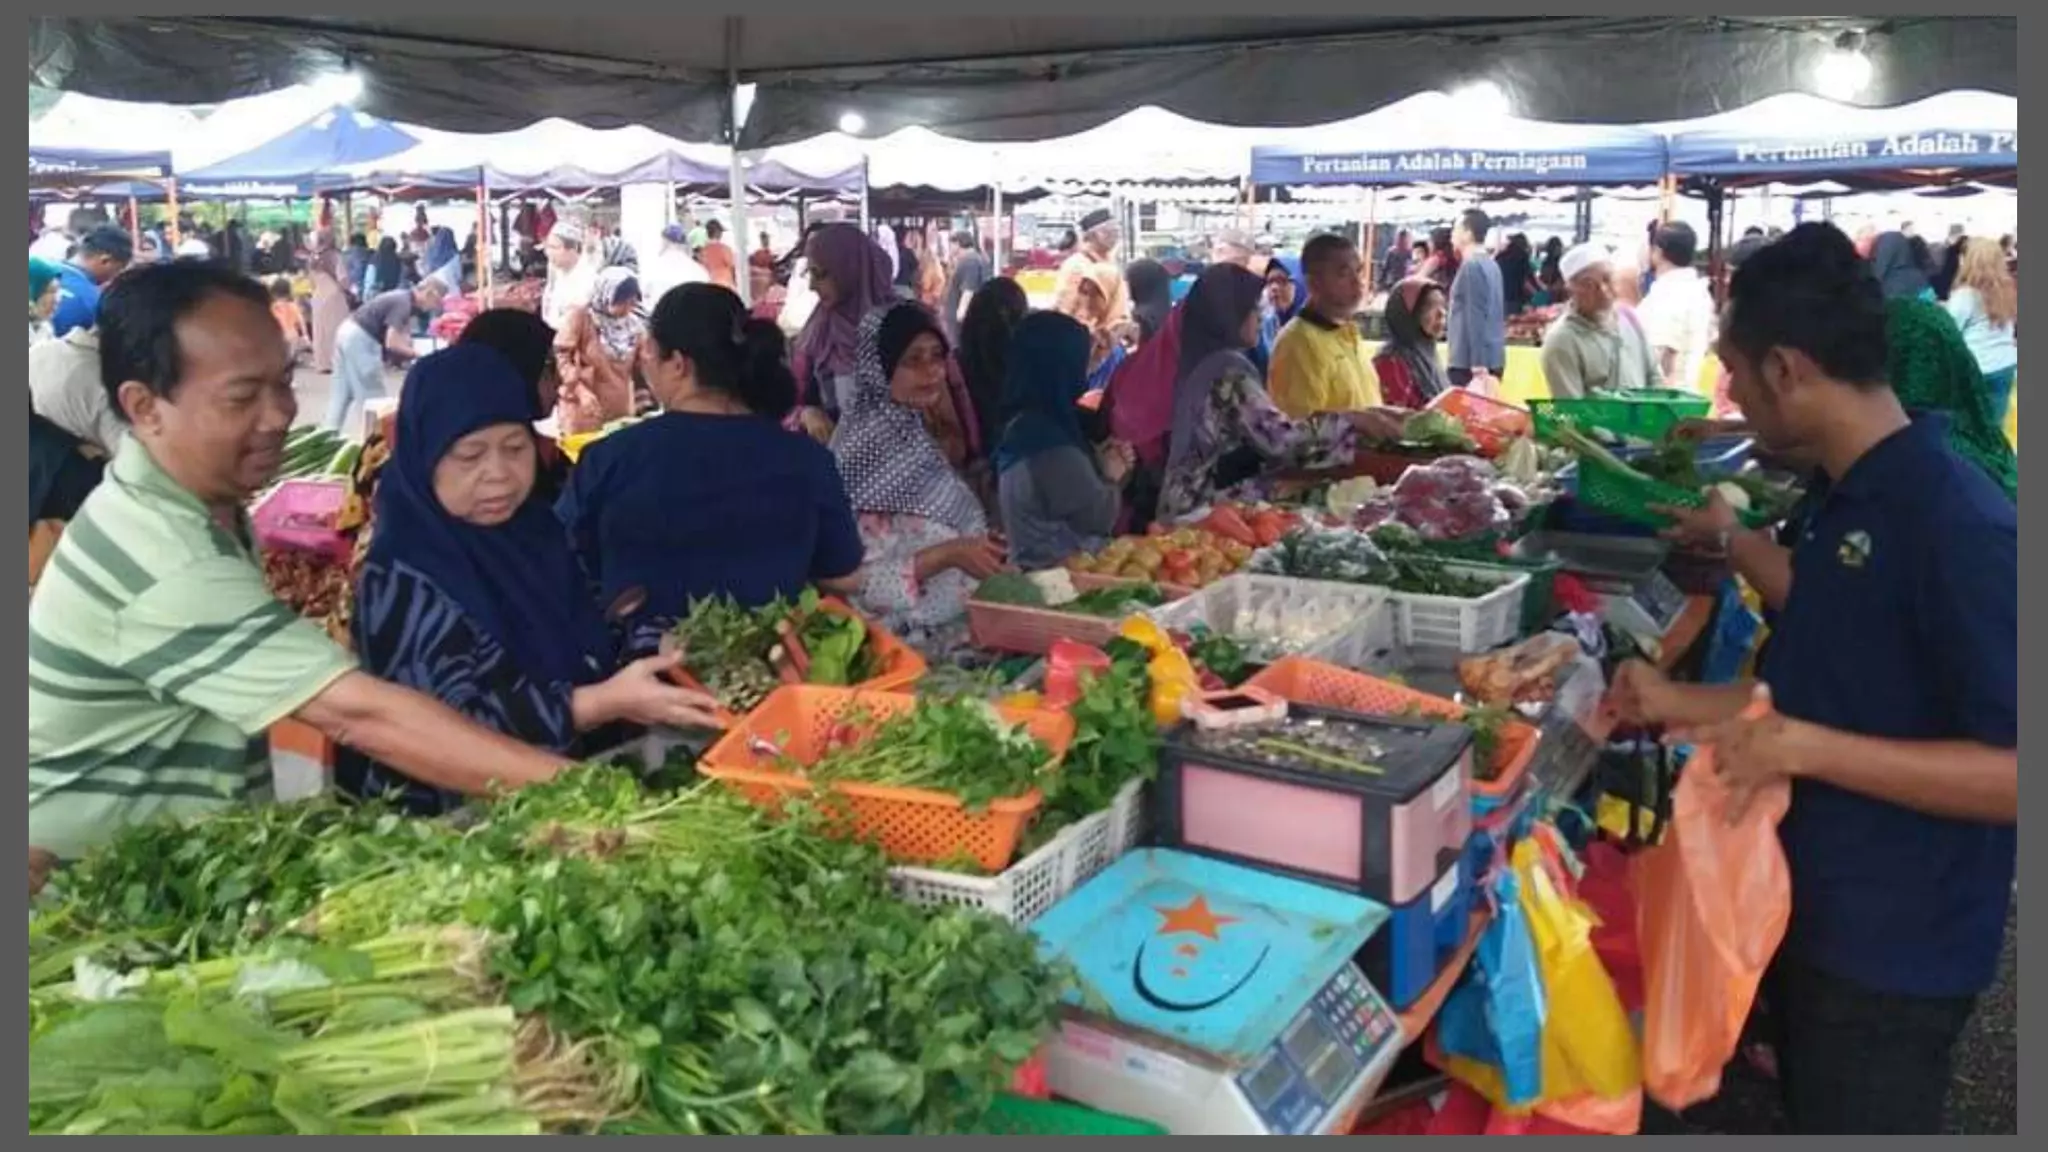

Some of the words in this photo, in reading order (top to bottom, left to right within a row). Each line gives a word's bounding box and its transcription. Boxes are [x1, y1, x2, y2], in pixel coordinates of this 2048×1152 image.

[1880, 132, 1979, 156] Adalah
[1303, 154, 1391, 173] Pertanian
[1395, 152, 1464, 171] Adalah
[1470, 152, 1587, 174] Perniagaan
